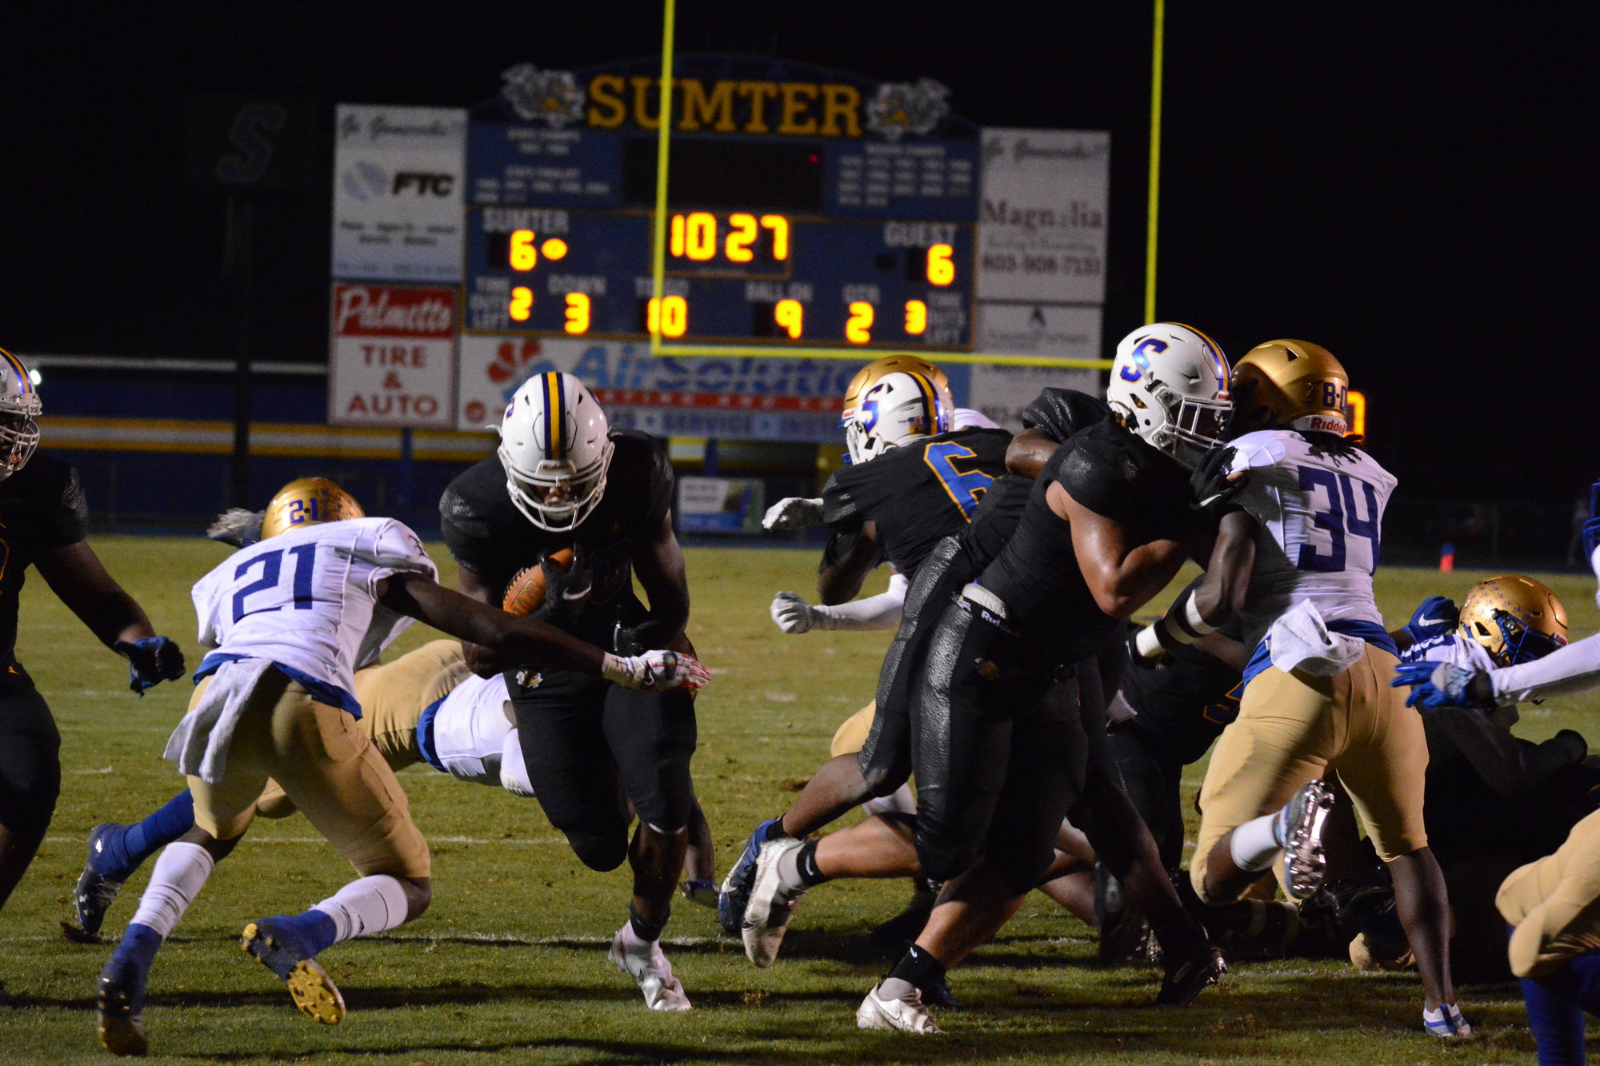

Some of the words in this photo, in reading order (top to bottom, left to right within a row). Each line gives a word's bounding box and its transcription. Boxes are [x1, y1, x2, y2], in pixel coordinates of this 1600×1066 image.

[587, 74, 863, 137] SUMTER
[392, 172, 453, 197] FTC
[509, 229, 537, 271] 6
[926, 244, 955, 286] 6
[337, 286, 452, 333] Palmetto
[509, 286, 533, 321] 2
[564, 292, 590, 335] 3
[647, 295, 688, 338] 10
[775, 298, 803, 339] 9
[846, 301, 874, 344] 2
[904, 300, 927, 335] 3
[362, 346, 428, 368] TIRE
[1119, 337, 1169, 384] S
[383, 371, 402, 389] &
[348, 395, 438, 417] AUTO
[1311, 417, 1347, 435] Riddel
[924, 440, 996, 524] 6
[289, 498, 318, 525] 21
[1297, 464, 1381, 577] 34
[232, 542, 317, 625] 21
